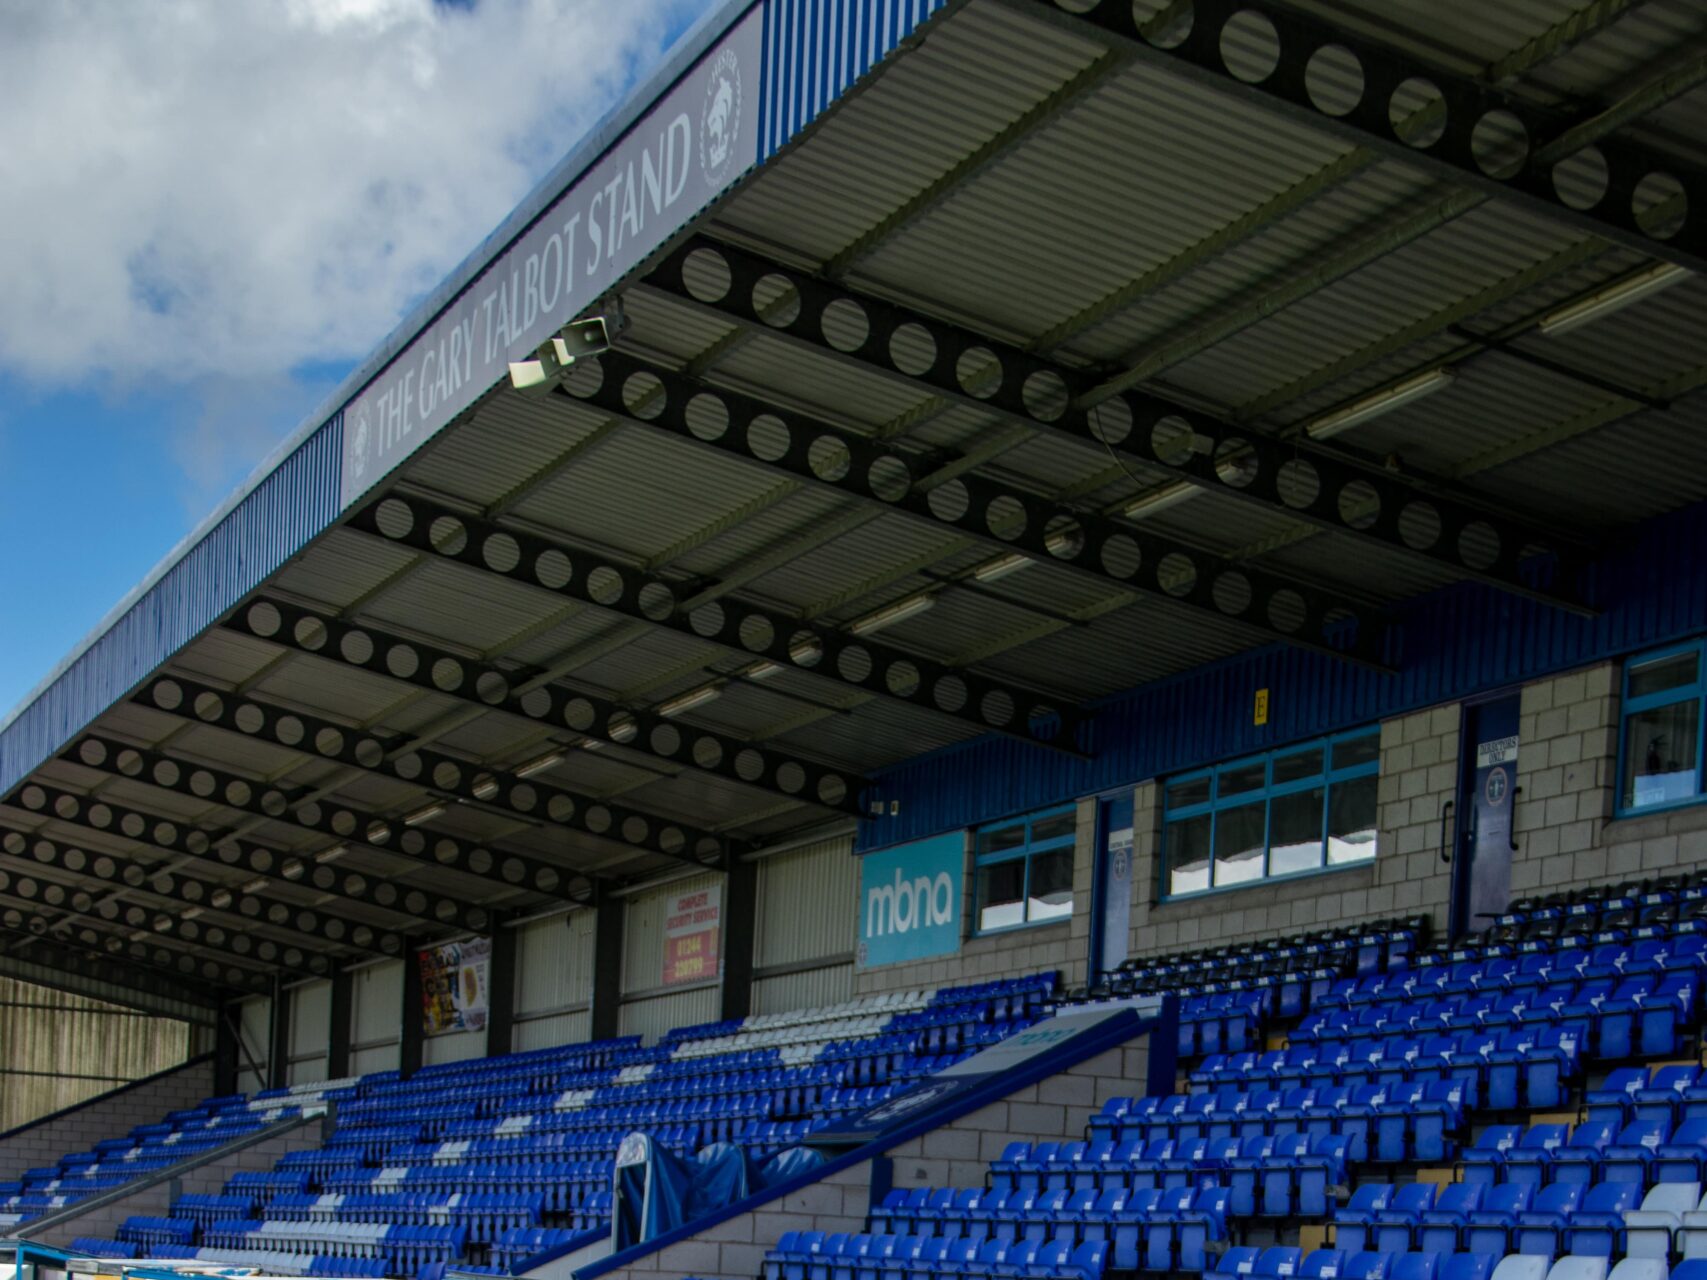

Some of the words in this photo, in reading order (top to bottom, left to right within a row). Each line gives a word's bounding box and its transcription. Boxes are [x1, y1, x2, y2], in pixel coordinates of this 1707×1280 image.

[377, 372, 414, 457] THE
[419, 309, 478, 416] GARY
[482, 212, 580, 364] TALBOT
[586, 112, 691, 276] STAND
[866, 867, 953, 938] mbna
